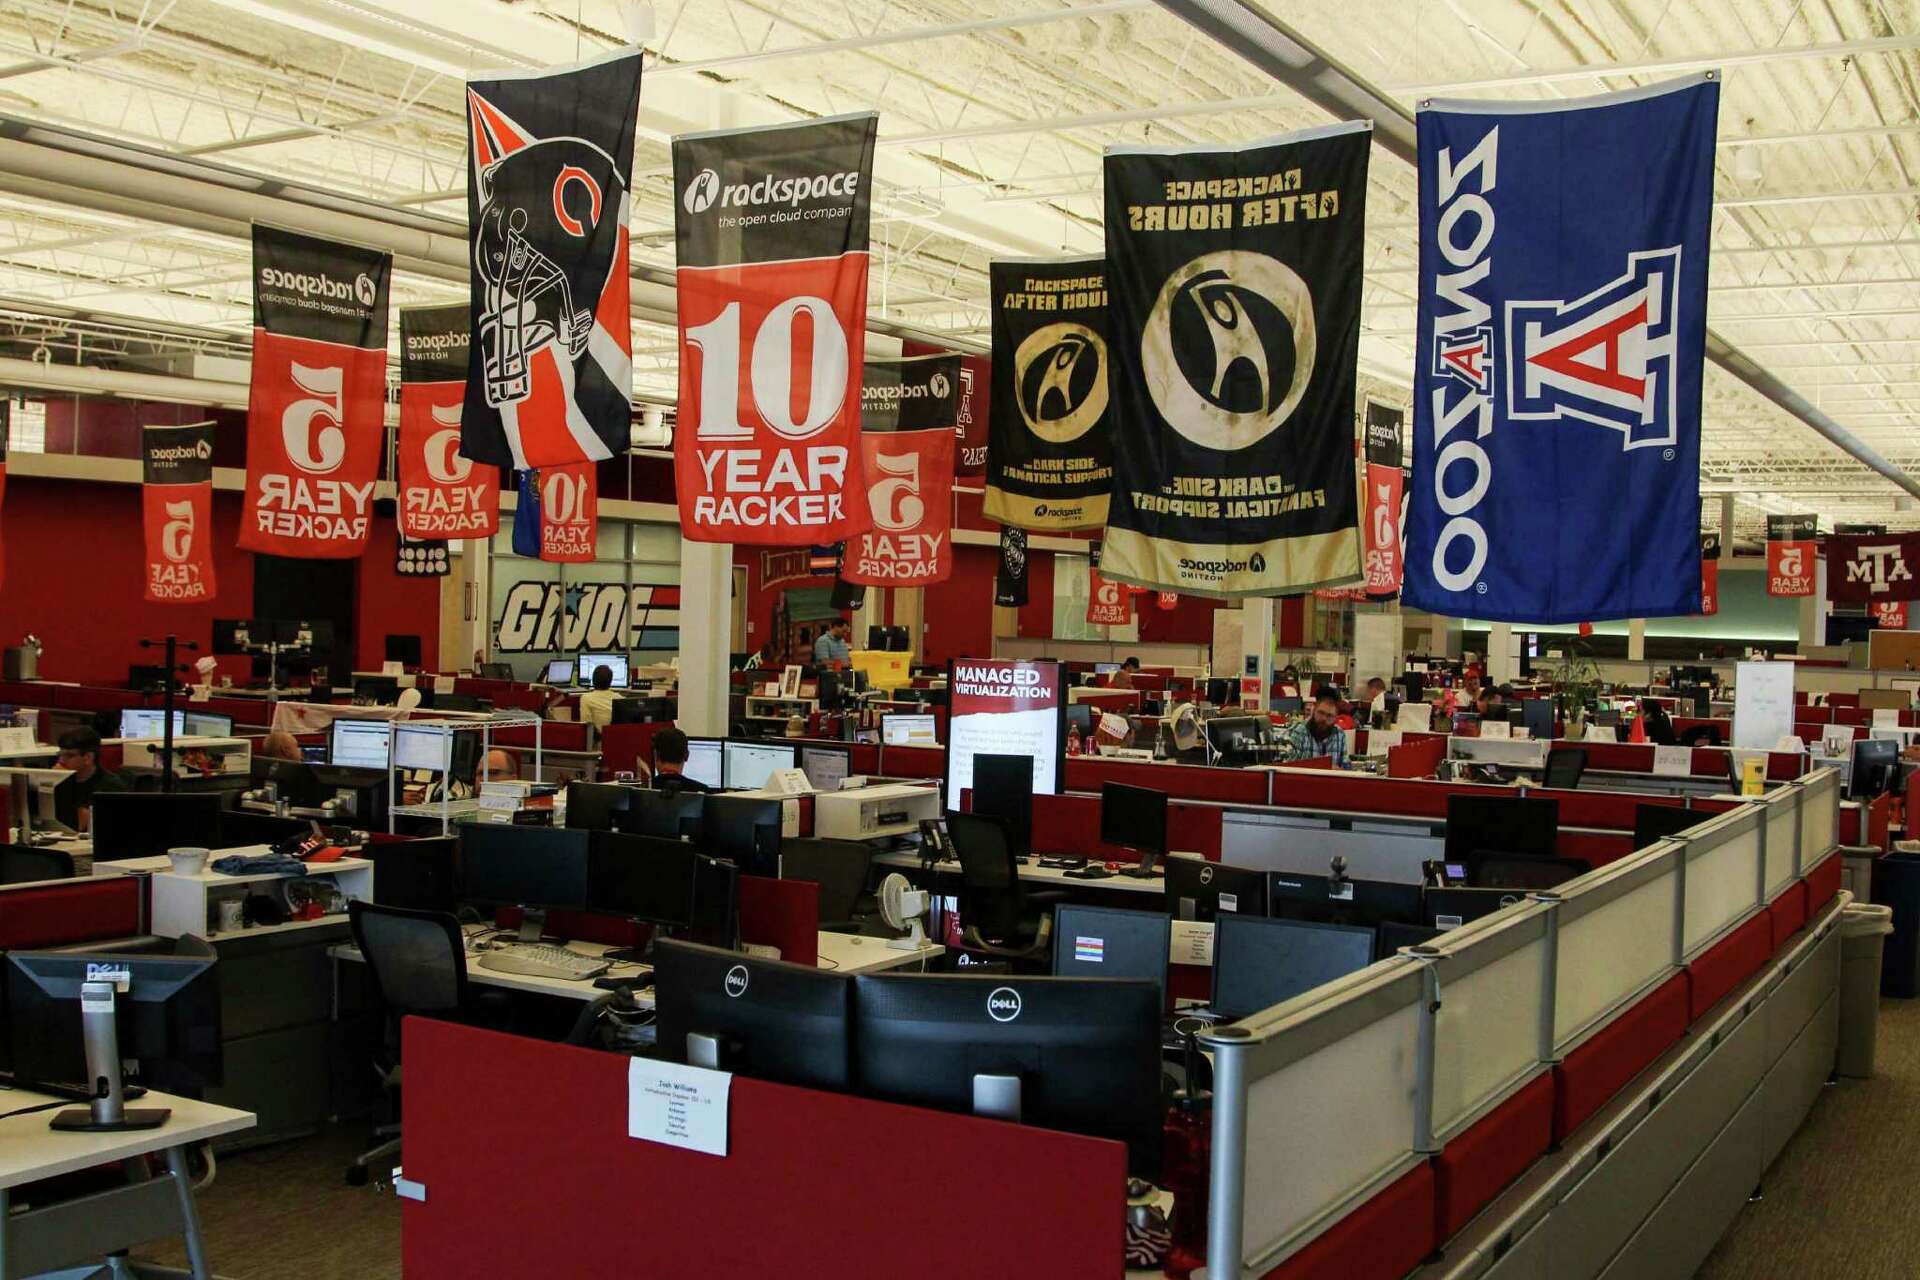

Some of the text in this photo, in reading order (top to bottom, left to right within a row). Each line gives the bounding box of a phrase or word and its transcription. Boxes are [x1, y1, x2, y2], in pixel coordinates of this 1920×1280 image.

[721, 171, 859, 208] rackspace
[719, 206, 853, 230] the open cloud compan
[1025, 276, 1104, 292] RACKSPACE
[1003, 290, 1108, 310] AFTER HOU
[686, 296, 849, 441] 10
[697, 446, 849, 493] YEAR
[1066, 457, 1096, 470] SIDE
[1065, 466, 1112, 484] SUPPORT
[694, 495, 846, 526] RACKER
[955, 666, 1041, 686] MANAGED
[955, 682, 1051, 699] VIRTUALIZATION
[728, 975, 746, 987] DELL
[991, 999, 1018, 1009] DELL
